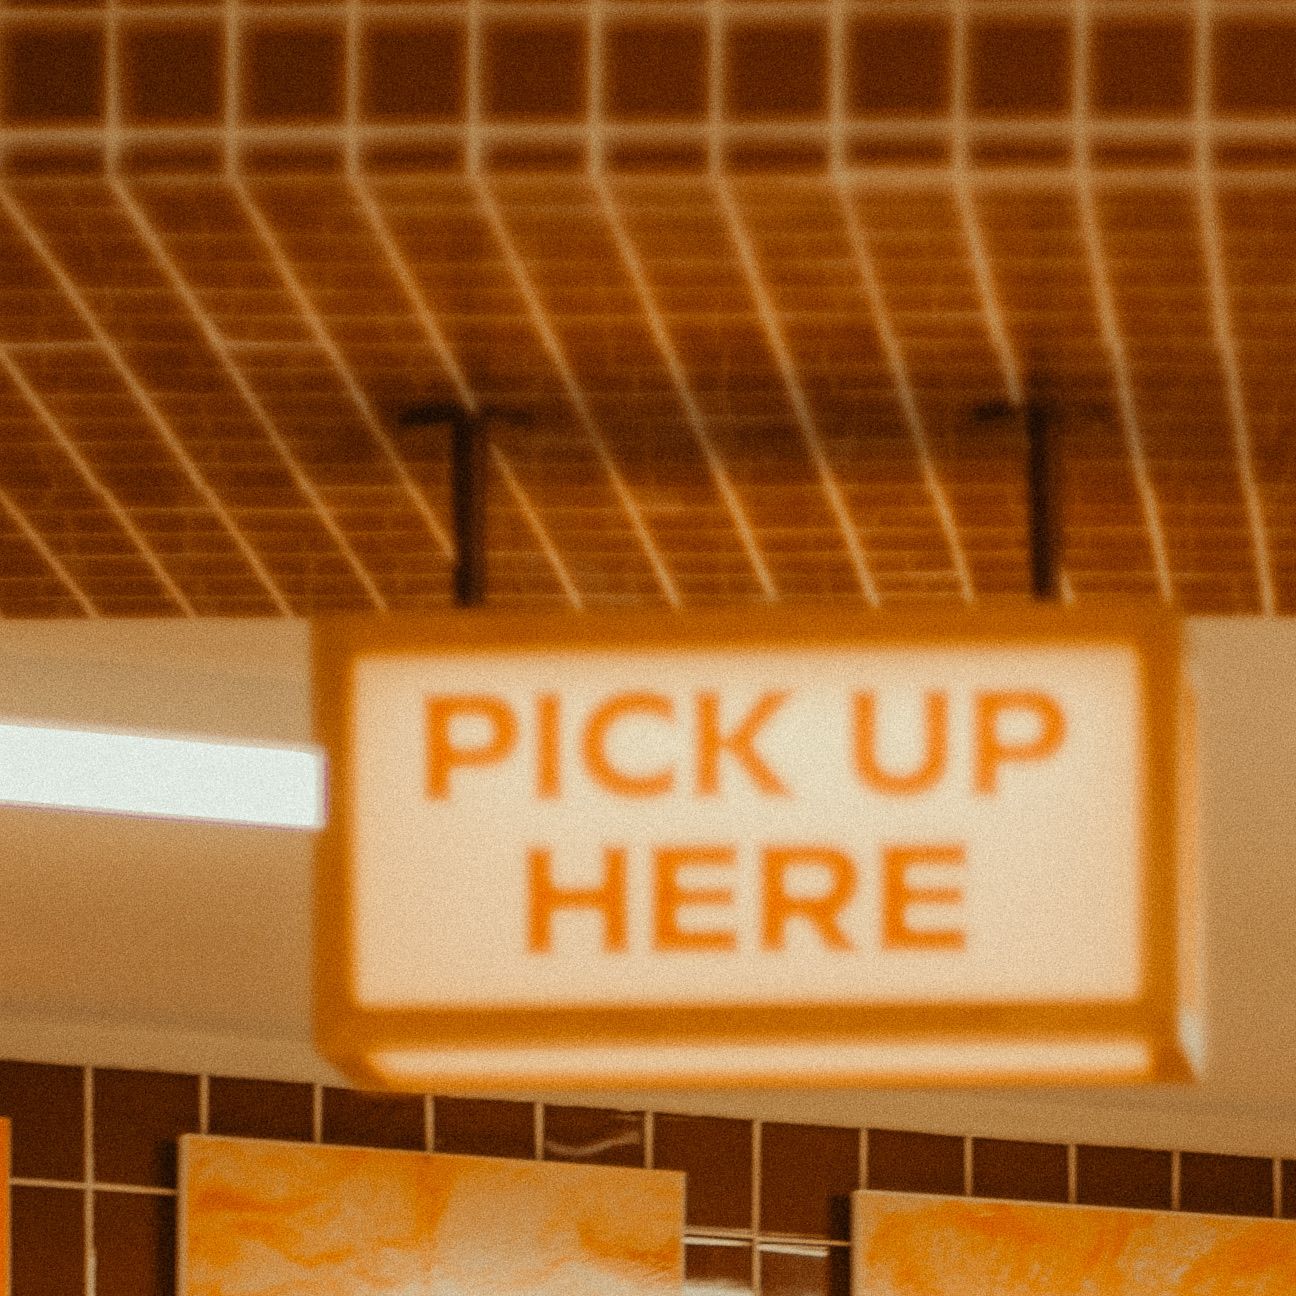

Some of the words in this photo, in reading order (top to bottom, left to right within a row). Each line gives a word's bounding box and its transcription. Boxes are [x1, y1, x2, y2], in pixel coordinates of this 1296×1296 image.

[424, 691, 792, 799] PICK
[852, 691, 1068, 796] UP
[525, 845, 967, 953] HERE
